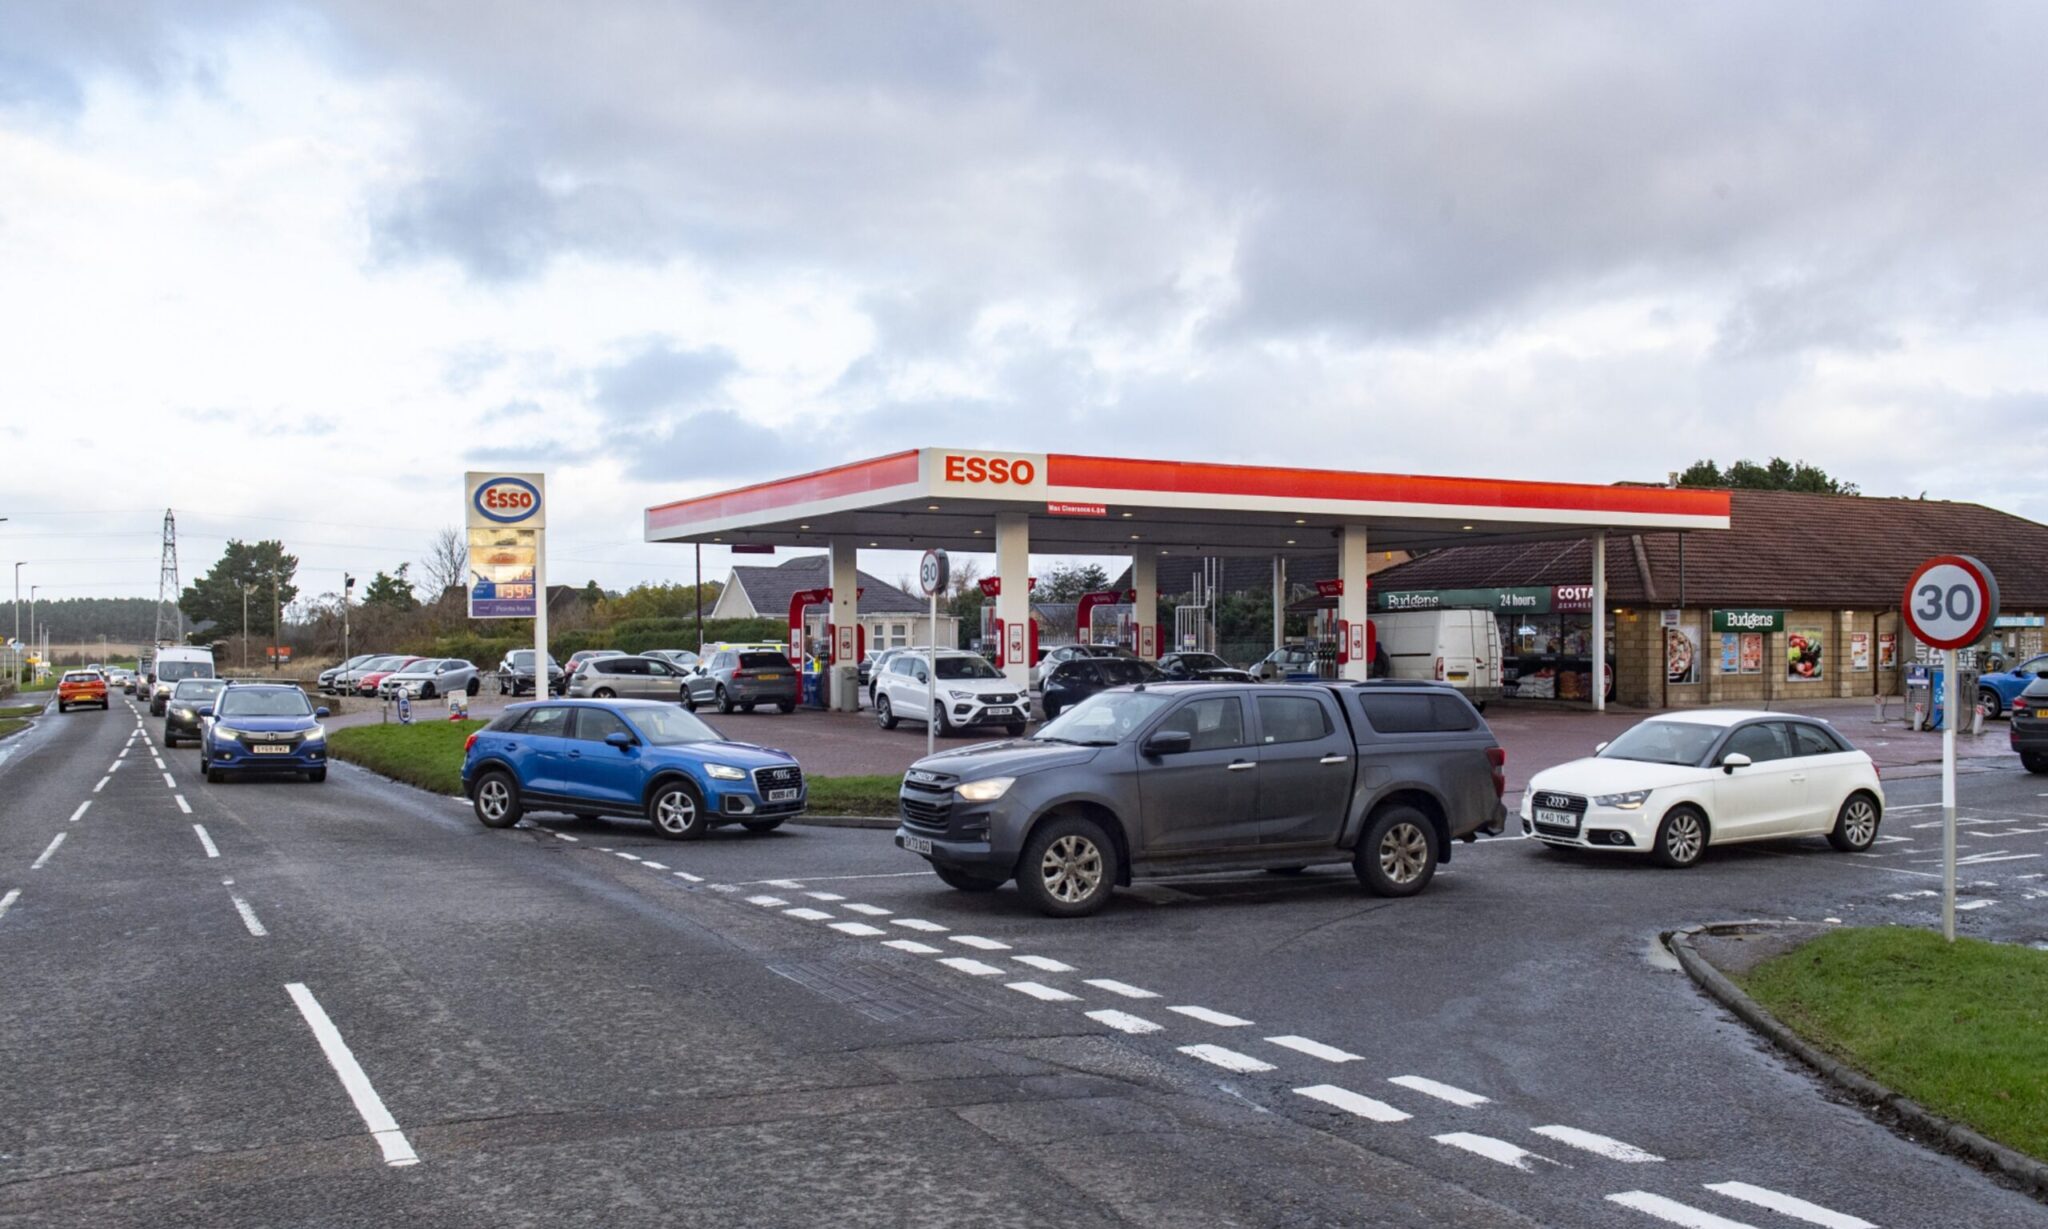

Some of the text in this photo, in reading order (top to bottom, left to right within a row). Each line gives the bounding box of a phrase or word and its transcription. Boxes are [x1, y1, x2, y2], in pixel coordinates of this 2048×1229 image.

[945, 455, 1035, 486] ESSO
[486, 488, 532, 508] Esso
[922, 565, 937, 583] 30
[1500, 593, 1536, 606] 24 hours
[1557, 588, 1593, 600] COSTA
[1916, 583, 1975, 622] 30
[1727, 612, 1774, 629] Budgens
